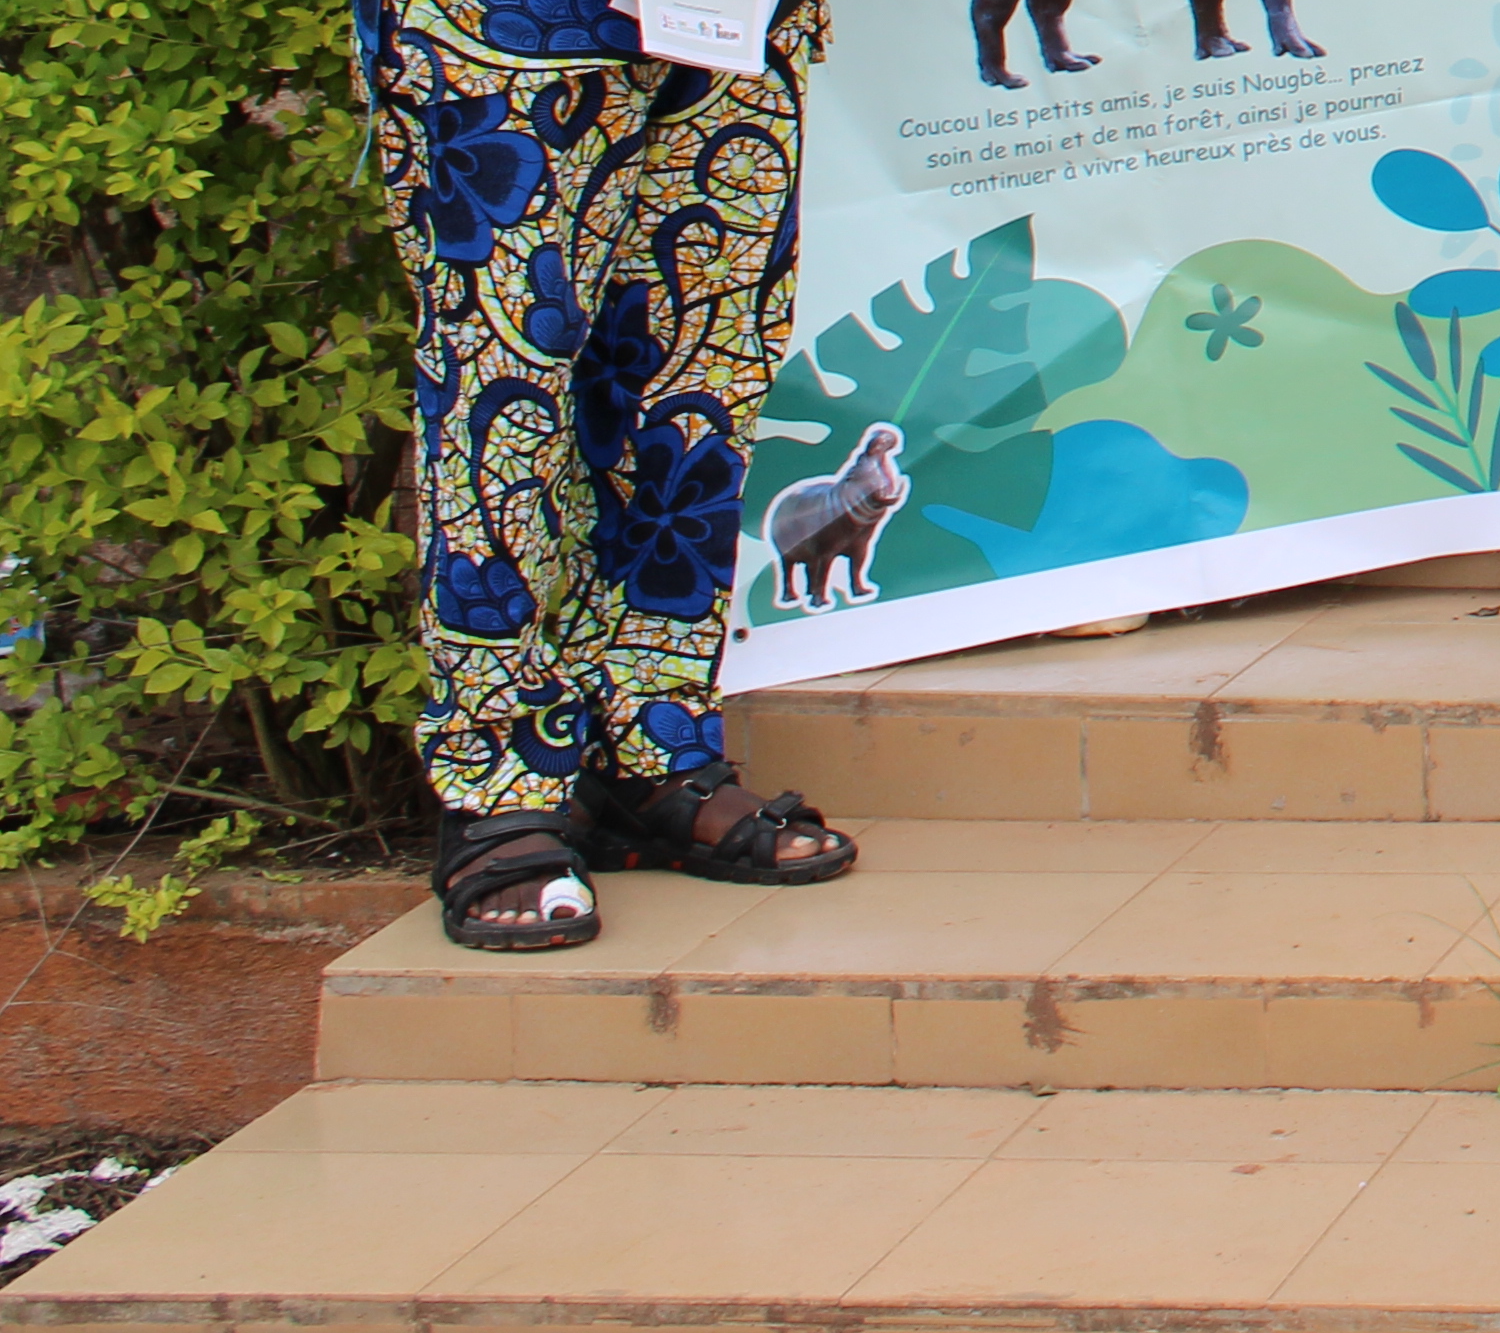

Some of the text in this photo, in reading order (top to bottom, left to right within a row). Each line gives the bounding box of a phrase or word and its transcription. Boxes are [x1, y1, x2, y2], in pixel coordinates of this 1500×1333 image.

[899, 116, 978, 138] Coucou
[987, 108, 1018, 127] les
[1025, 100, 1093, 128] petits
[1100, 90, 1156, 112] amis,
[1163, 85, 1185, 108] je
[1192, 77, 1235, 98] suis
[1350, 57, 1423, 86] prenez
[926, 87, 1401, 168] soin de moi et de ma forêt, ainsi je pourrai
[950, 124, 1385, 196] continuer à vivre heureux près de vous.
